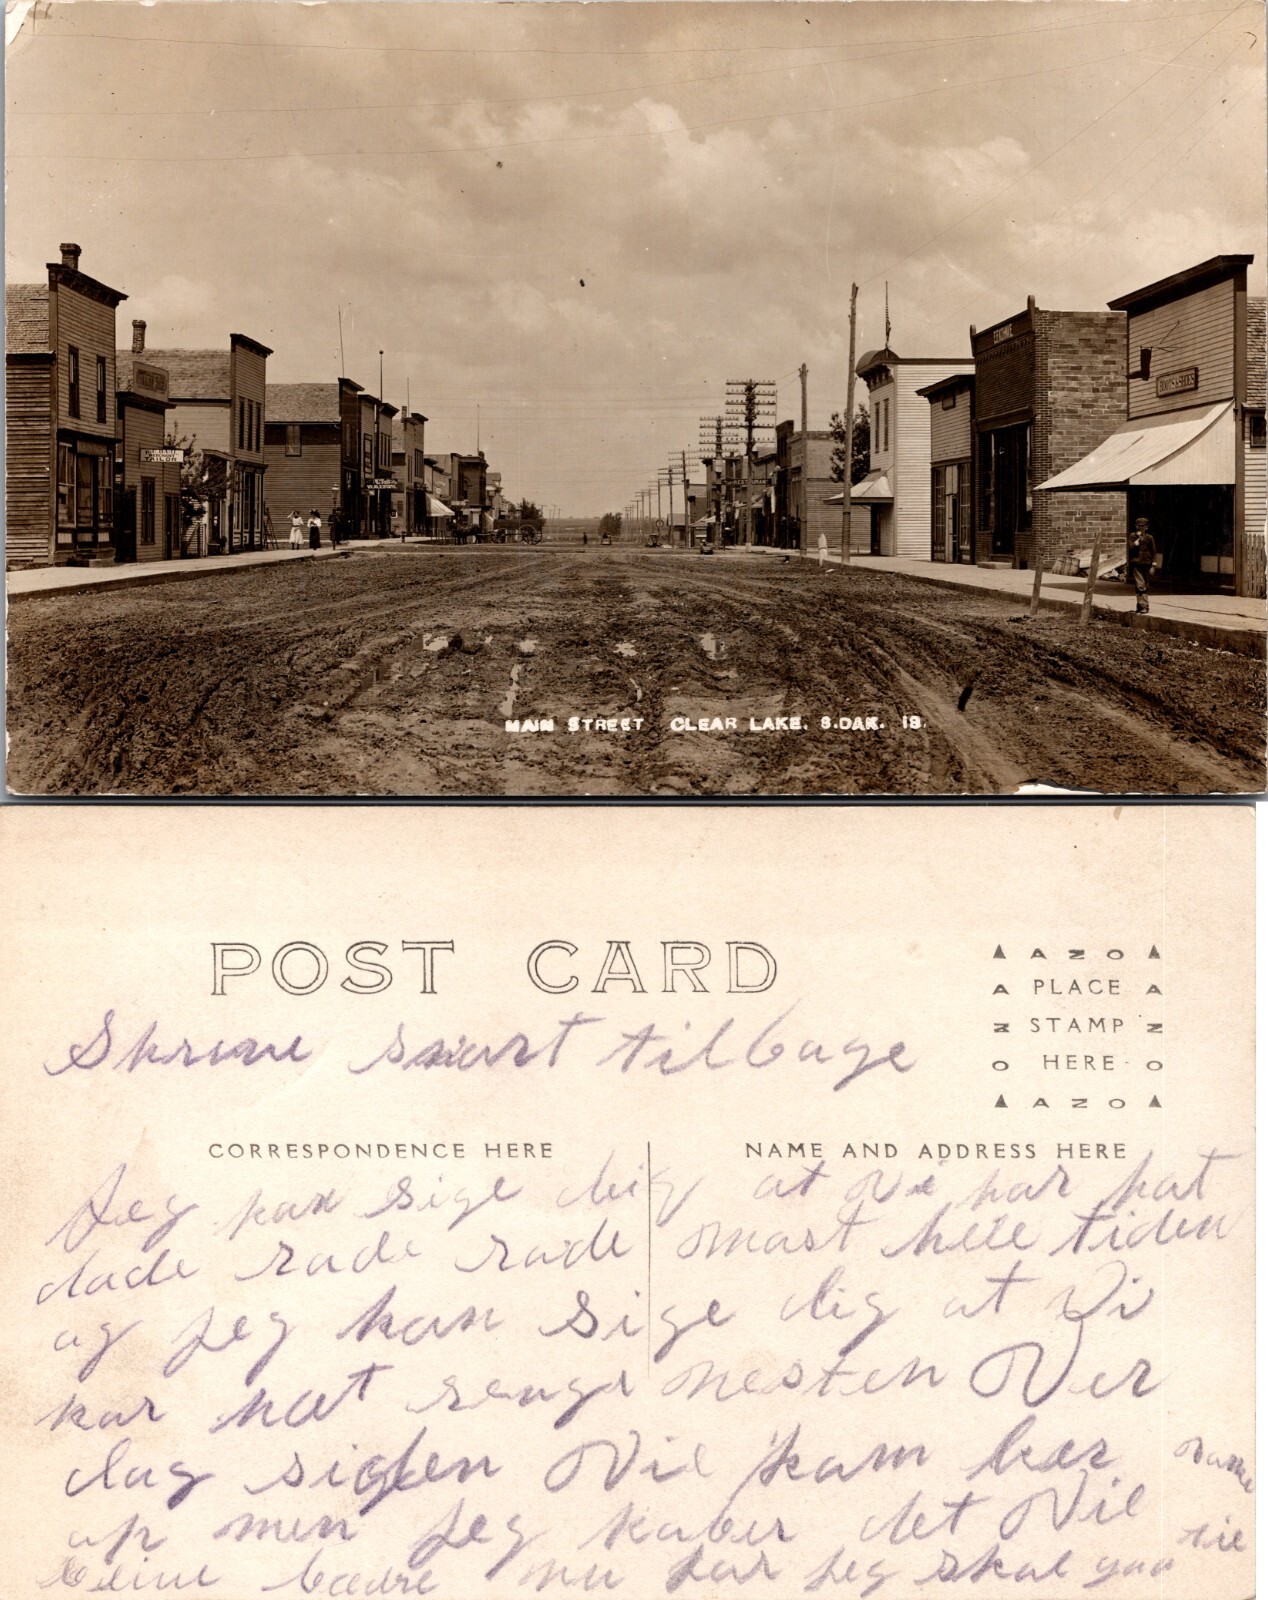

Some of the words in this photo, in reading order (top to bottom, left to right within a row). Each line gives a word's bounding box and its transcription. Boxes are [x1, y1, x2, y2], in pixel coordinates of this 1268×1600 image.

[210, 940, 455, 995] POST
[527, 939, 778, 994] CARD
[1034, 979, 1120, 995] PLACE
[1030, 1017, 1124, 1033] STAMP
[1043, 1054, 1115, 1071] HERE
[208, 1143, 465, 1159] CORRESPONDENCE
[485, 1143, 554, 1159] HERE
[746, 1142, 823, 1158] NAME
[843, 1142, 898, 1158] AND
[918, 1143, 1036, 1159] ADDRESS
[1057, 1143, 1127, 1159] HERE
